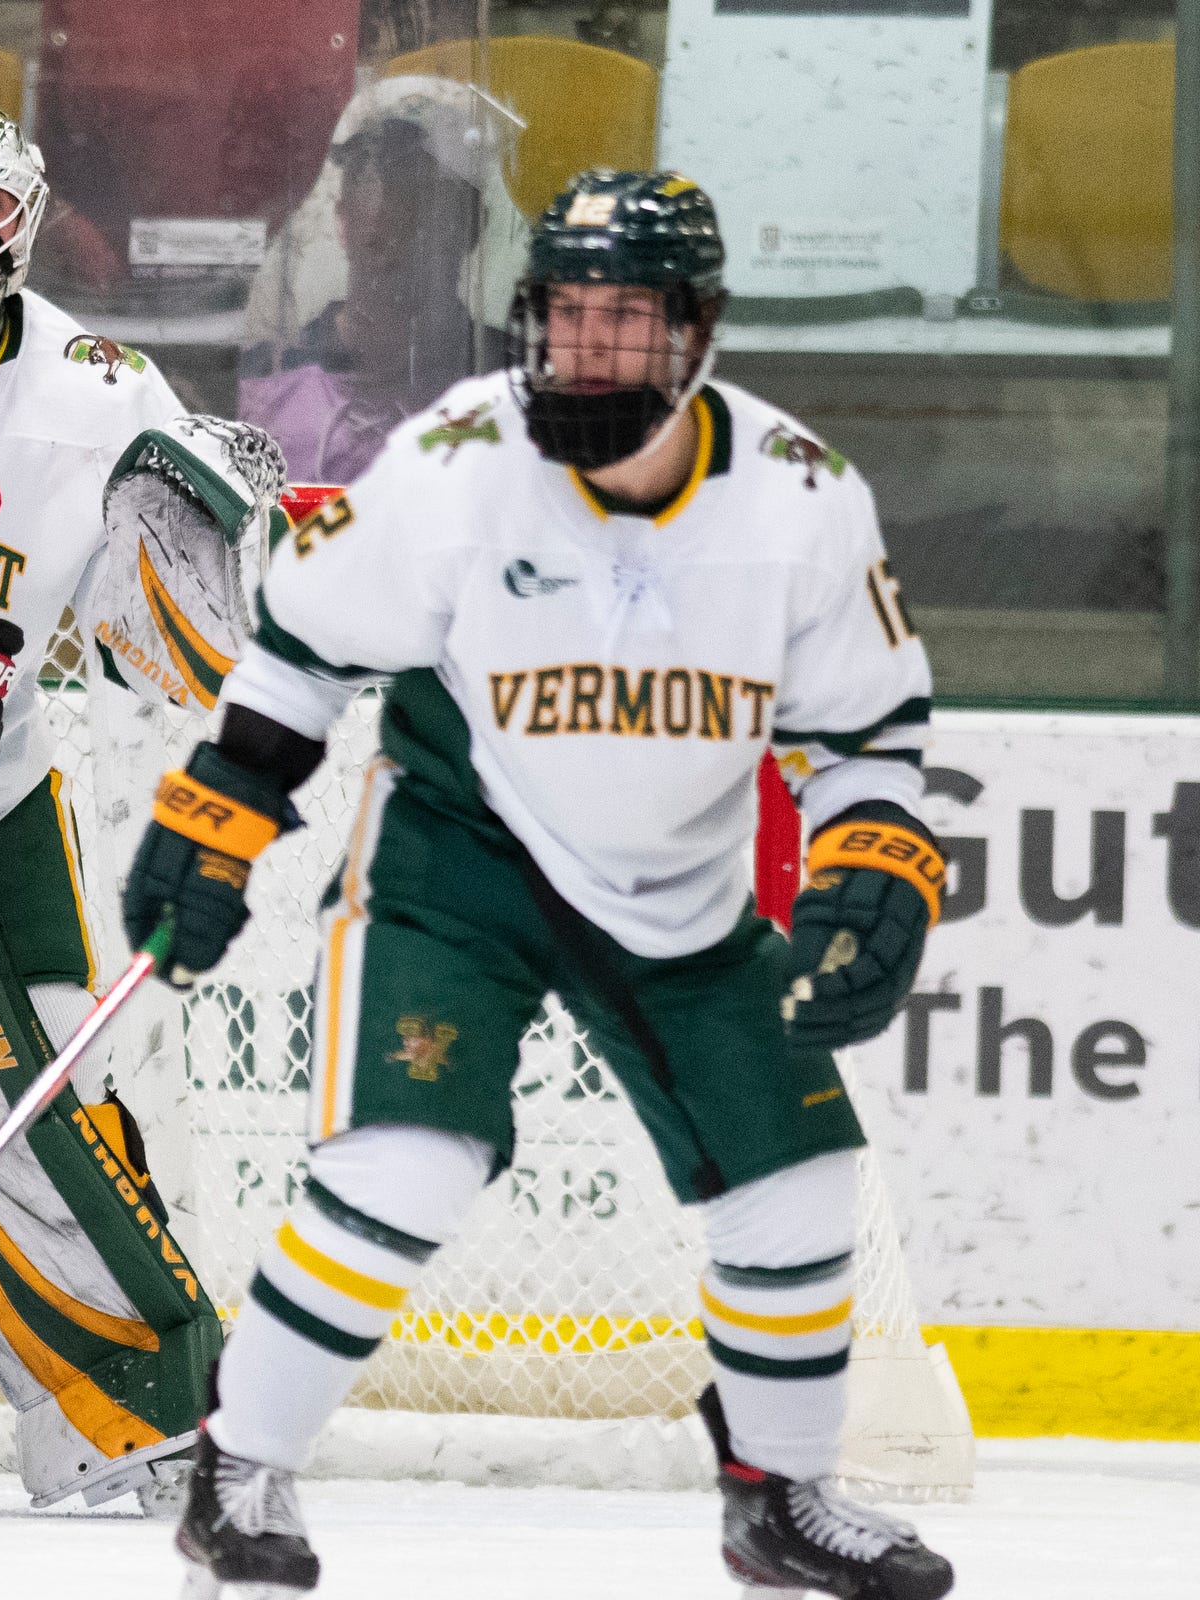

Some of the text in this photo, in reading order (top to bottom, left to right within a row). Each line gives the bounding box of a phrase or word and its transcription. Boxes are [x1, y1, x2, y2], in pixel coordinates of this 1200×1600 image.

[489, 663, 774, 741] VERMONT
[897, 986, 1147, 1102] The
[71, 1108, 199, 1302] VAUGHN
